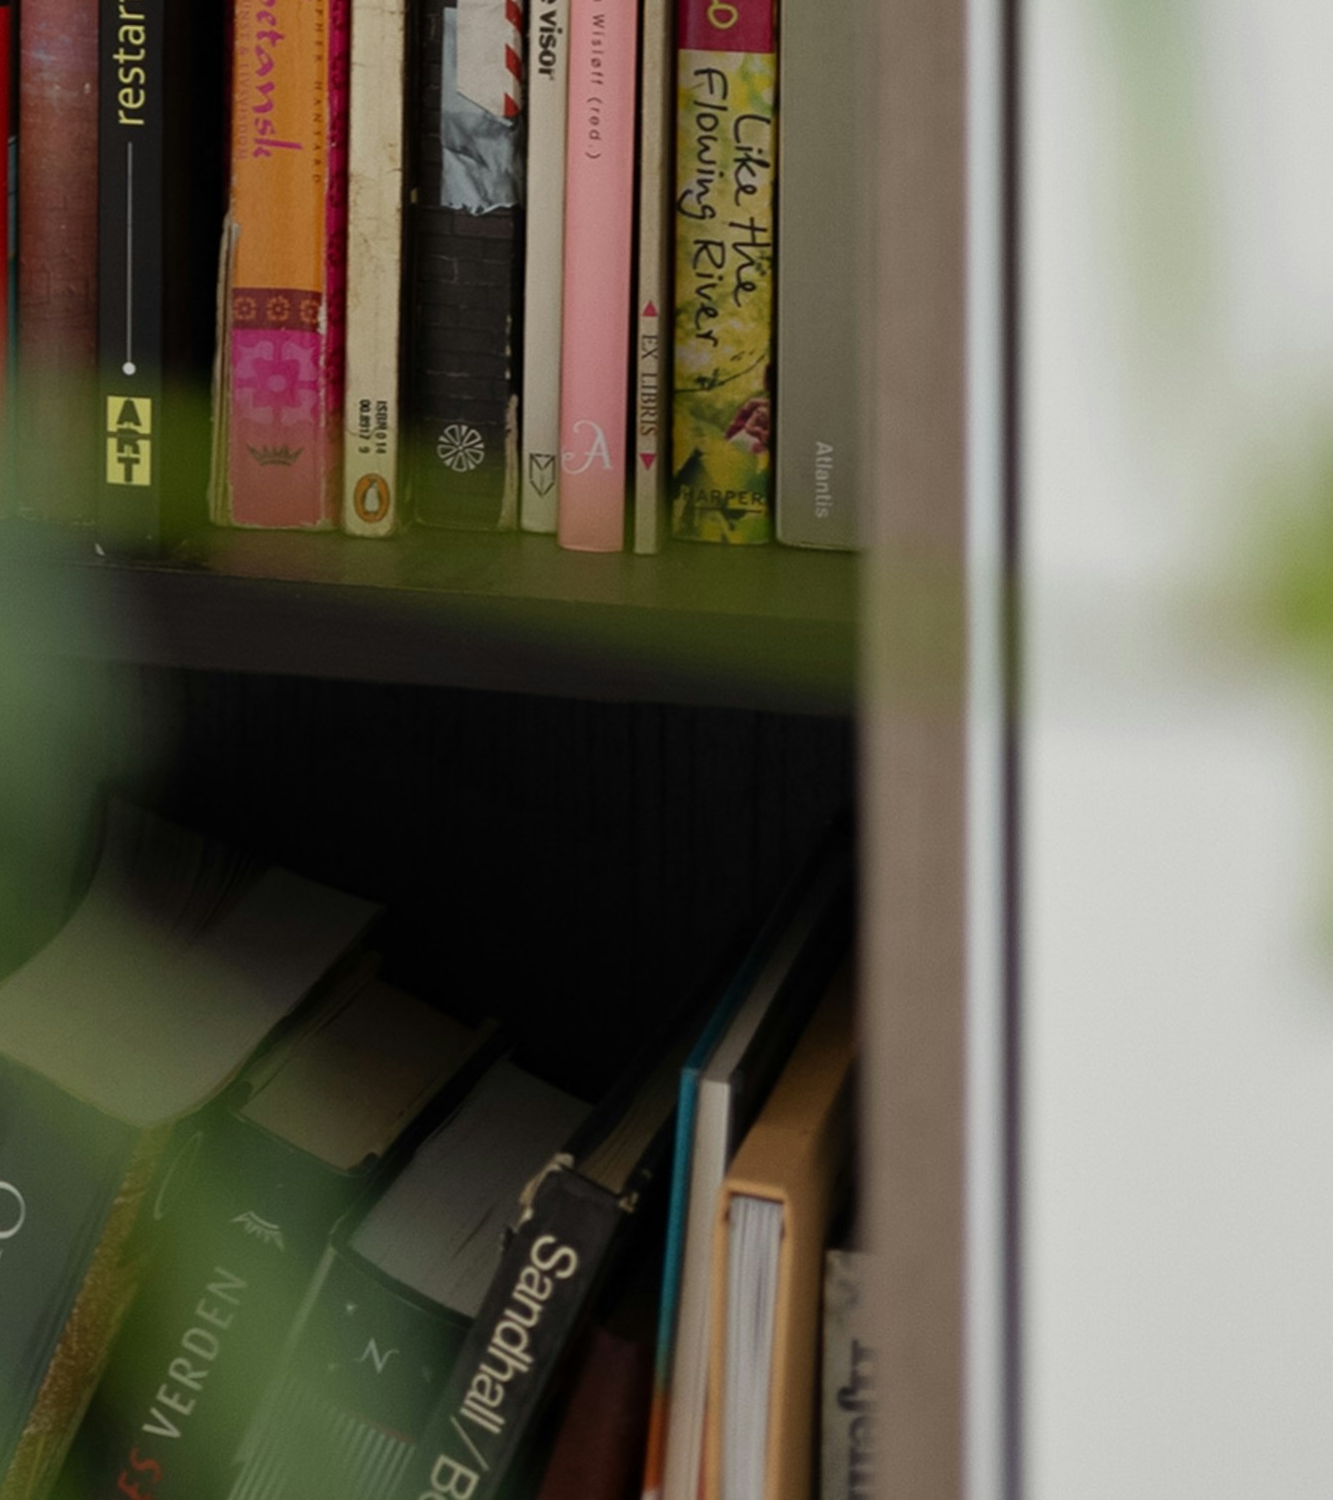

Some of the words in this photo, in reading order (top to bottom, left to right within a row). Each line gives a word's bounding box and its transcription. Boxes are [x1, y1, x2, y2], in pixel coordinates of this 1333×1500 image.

[537, 10, 562, 81] visor
[675, 68, 727, 221] Flowing
[733, 114, 771, 207] Like
[693, 240, 725, 347] River
[729, 217, 771, 308] the
[640, 333, 657, 360] EX
[640, 372, 658, 437] LIBRIS
[813, 441, 834, 519] Atlantis
[142, 1265, 248, 1440] VERDEN
[458, 1233, 578, 1435] Sandhall
